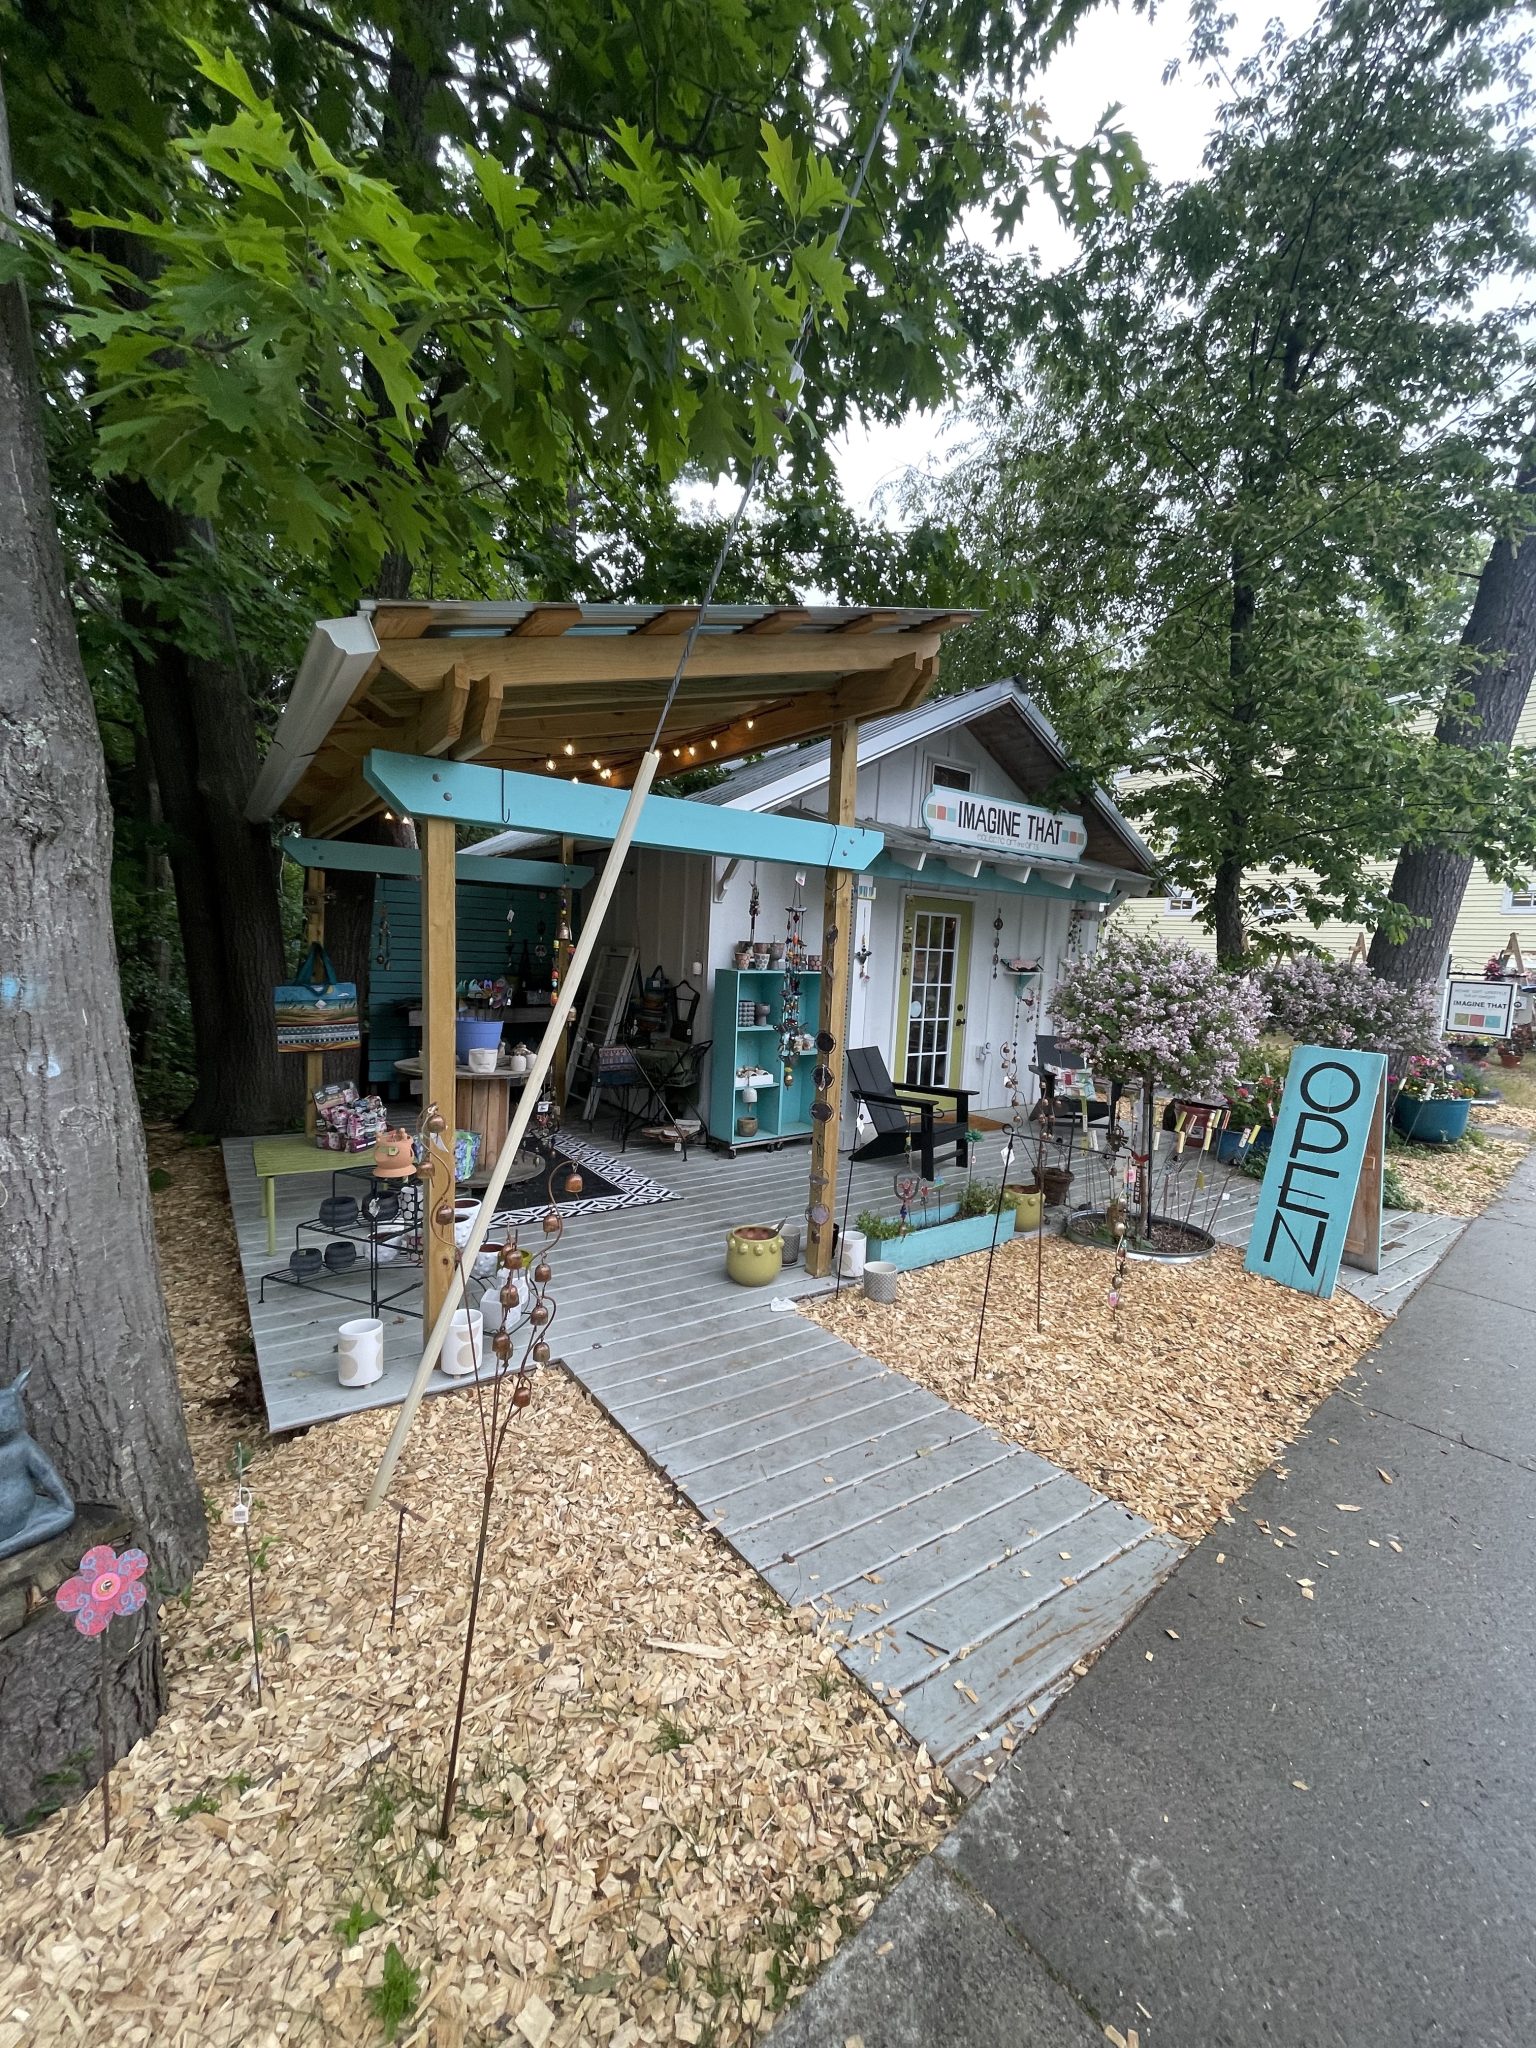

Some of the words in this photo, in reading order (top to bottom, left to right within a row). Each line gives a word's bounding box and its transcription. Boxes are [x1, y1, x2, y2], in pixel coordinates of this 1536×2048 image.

[958, 801, 1021, 838] IMAGINE
[1027, 814, 1063, 845] THAT
[1453, 1000, 1485, 1008] IMAGINE
[1263, 1062, 1361, 1277] OPEN
